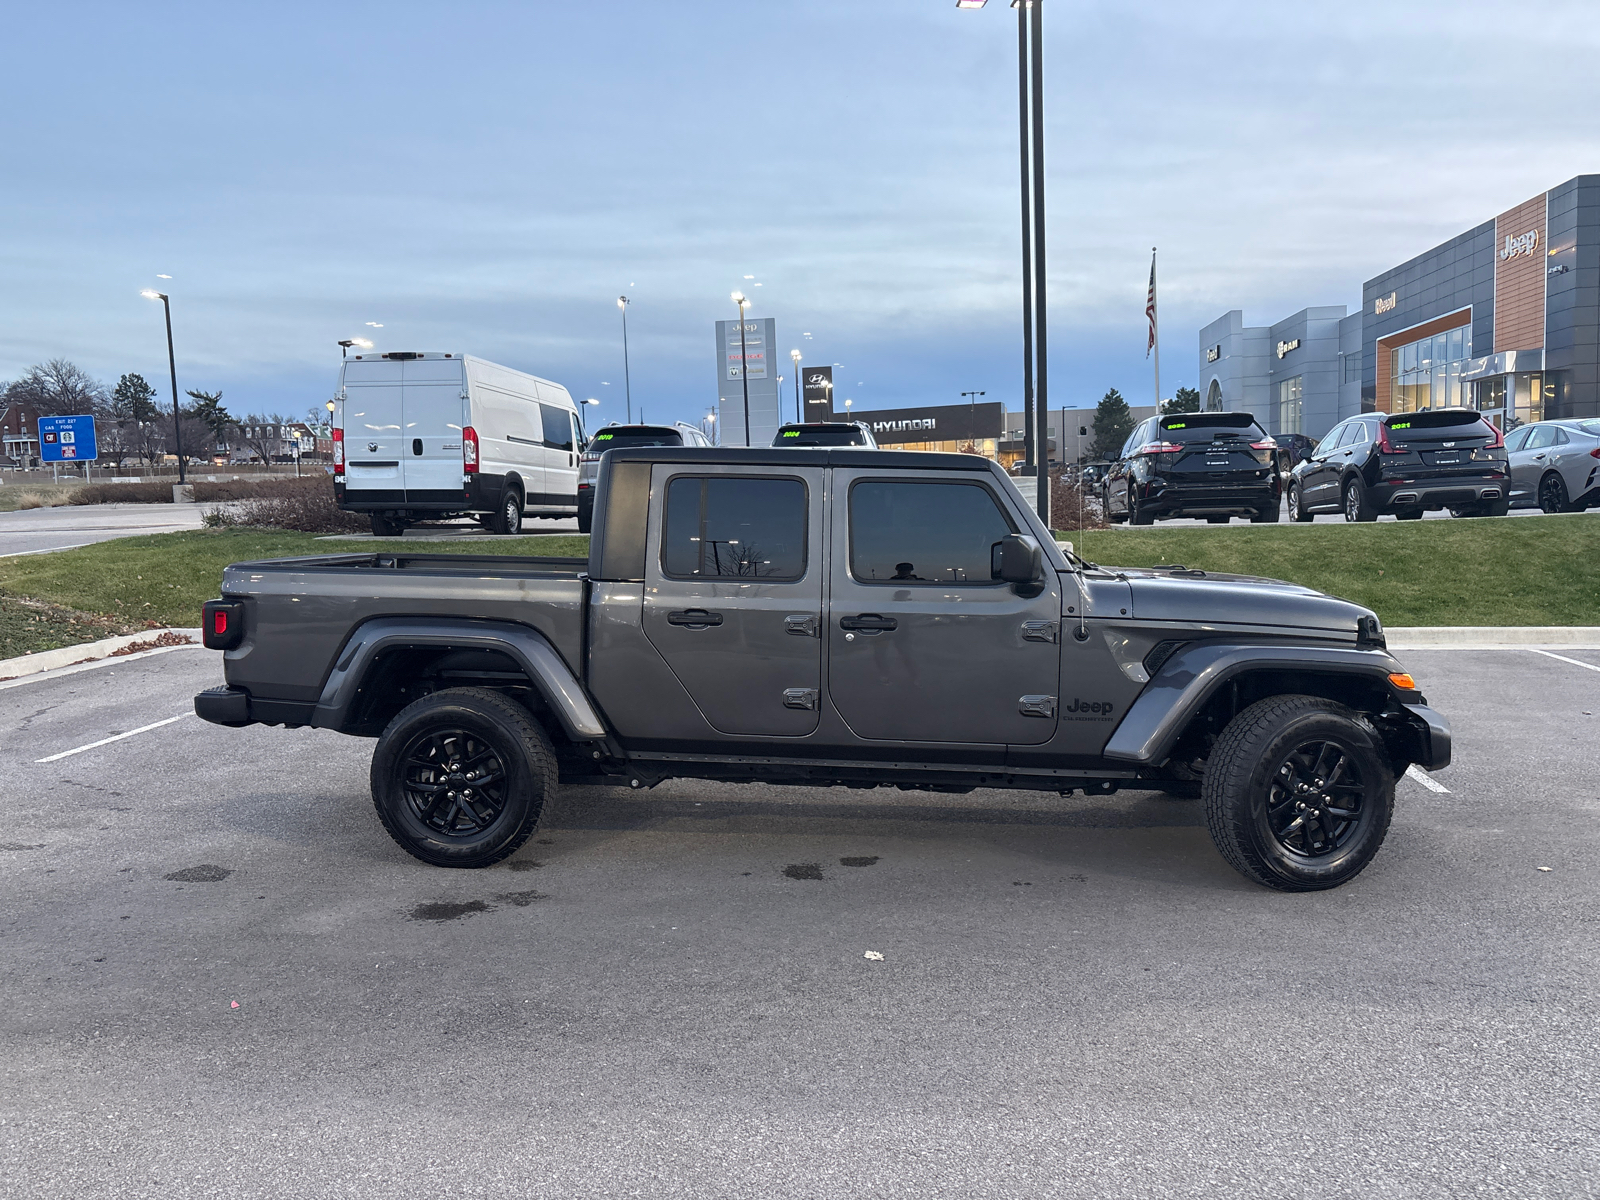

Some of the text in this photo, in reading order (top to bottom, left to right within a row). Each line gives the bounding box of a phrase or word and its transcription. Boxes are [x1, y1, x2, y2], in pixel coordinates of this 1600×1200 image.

[1500, 229, 1539, 261] Jeep
[732, 323, 757, 332] Jep
[1283, 339, 1300, 353] RAM
[873, 418, 936, 432] HYUNDAI
[1391, 422, 1411, 430] 2021
[1066, 698, 1114, 716] Jeep
